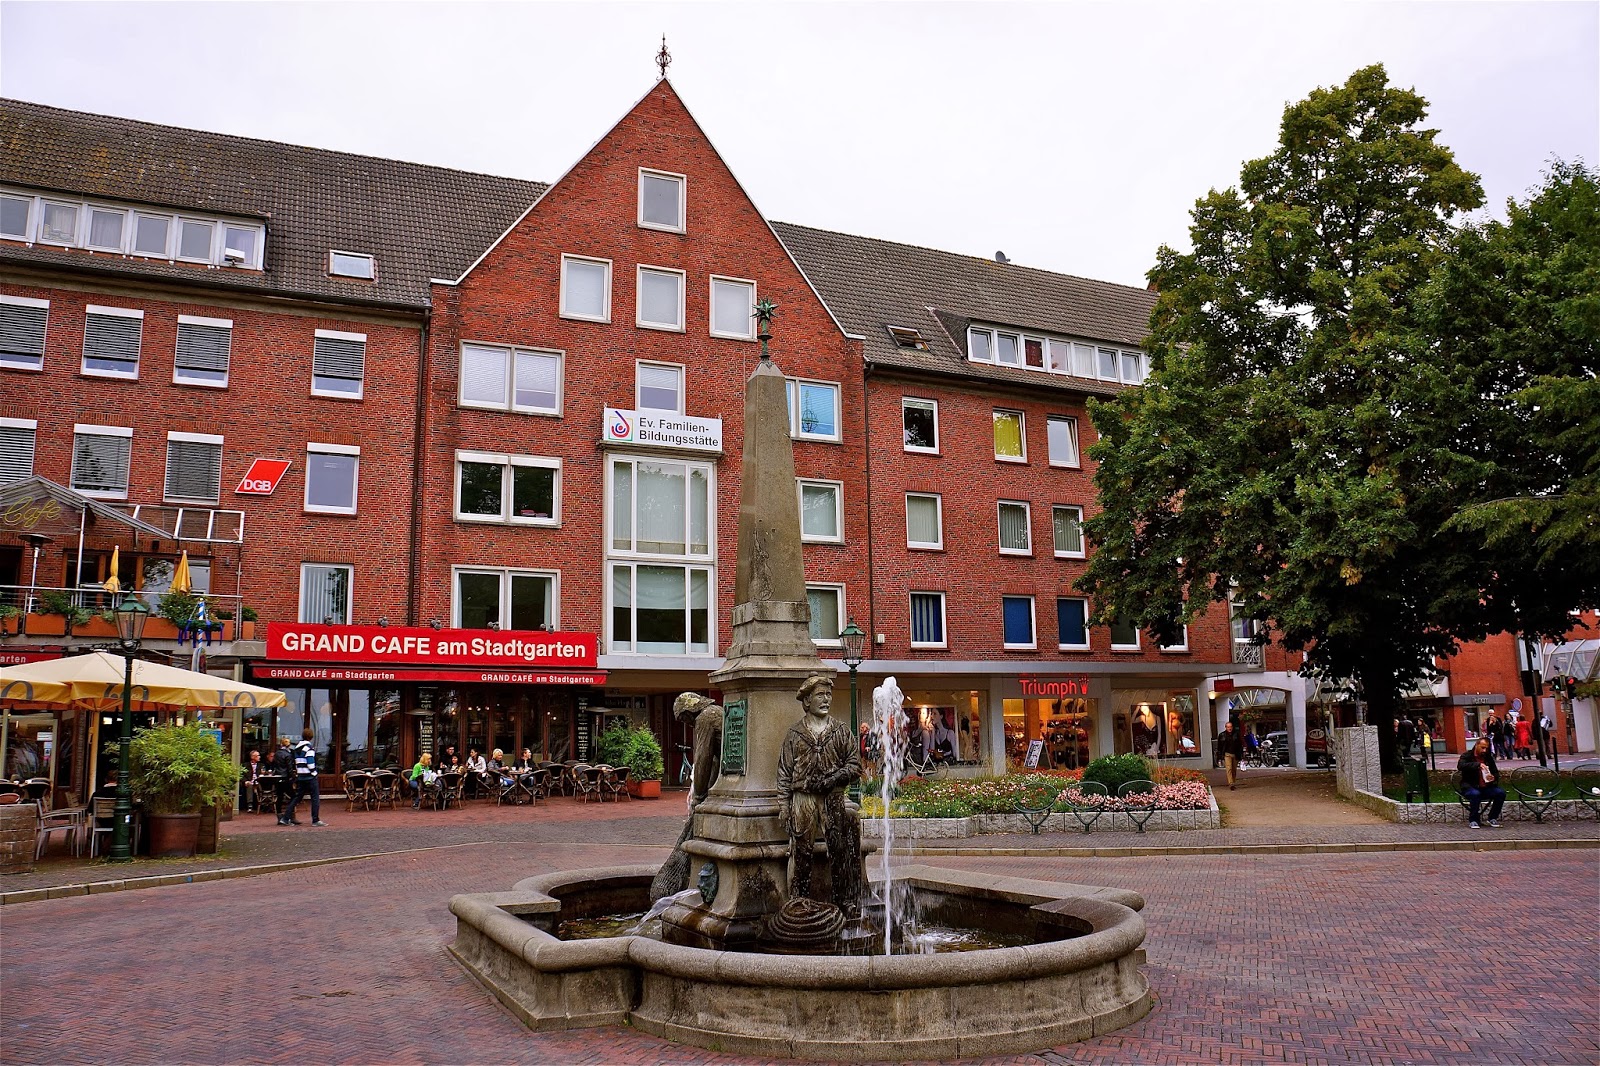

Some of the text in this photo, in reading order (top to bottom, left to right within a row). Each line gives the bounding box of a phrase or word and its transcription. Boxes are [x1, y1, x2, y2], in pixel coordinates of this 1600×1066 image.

[639, 417, 709, 433] Ev. Familien-
[639, 430, 719, 447] Bildungsstätte
[243, 479, 272, 491] DGB
[281, 632, 586, 661] GRAND CAFE am Stadtgarten
[270, 669, 302, 678] GRAND
[303, 669, 327, 678] CAFÉ
[345, 671, 395, 680] Stadtgarten
[481, 674, 510, 682] GRAND
[511, 674, 533, 683] CAFÉ
[549, 675, 594, 685] Stadtgarten
[1019, 679, 1077, 699] Triumph
